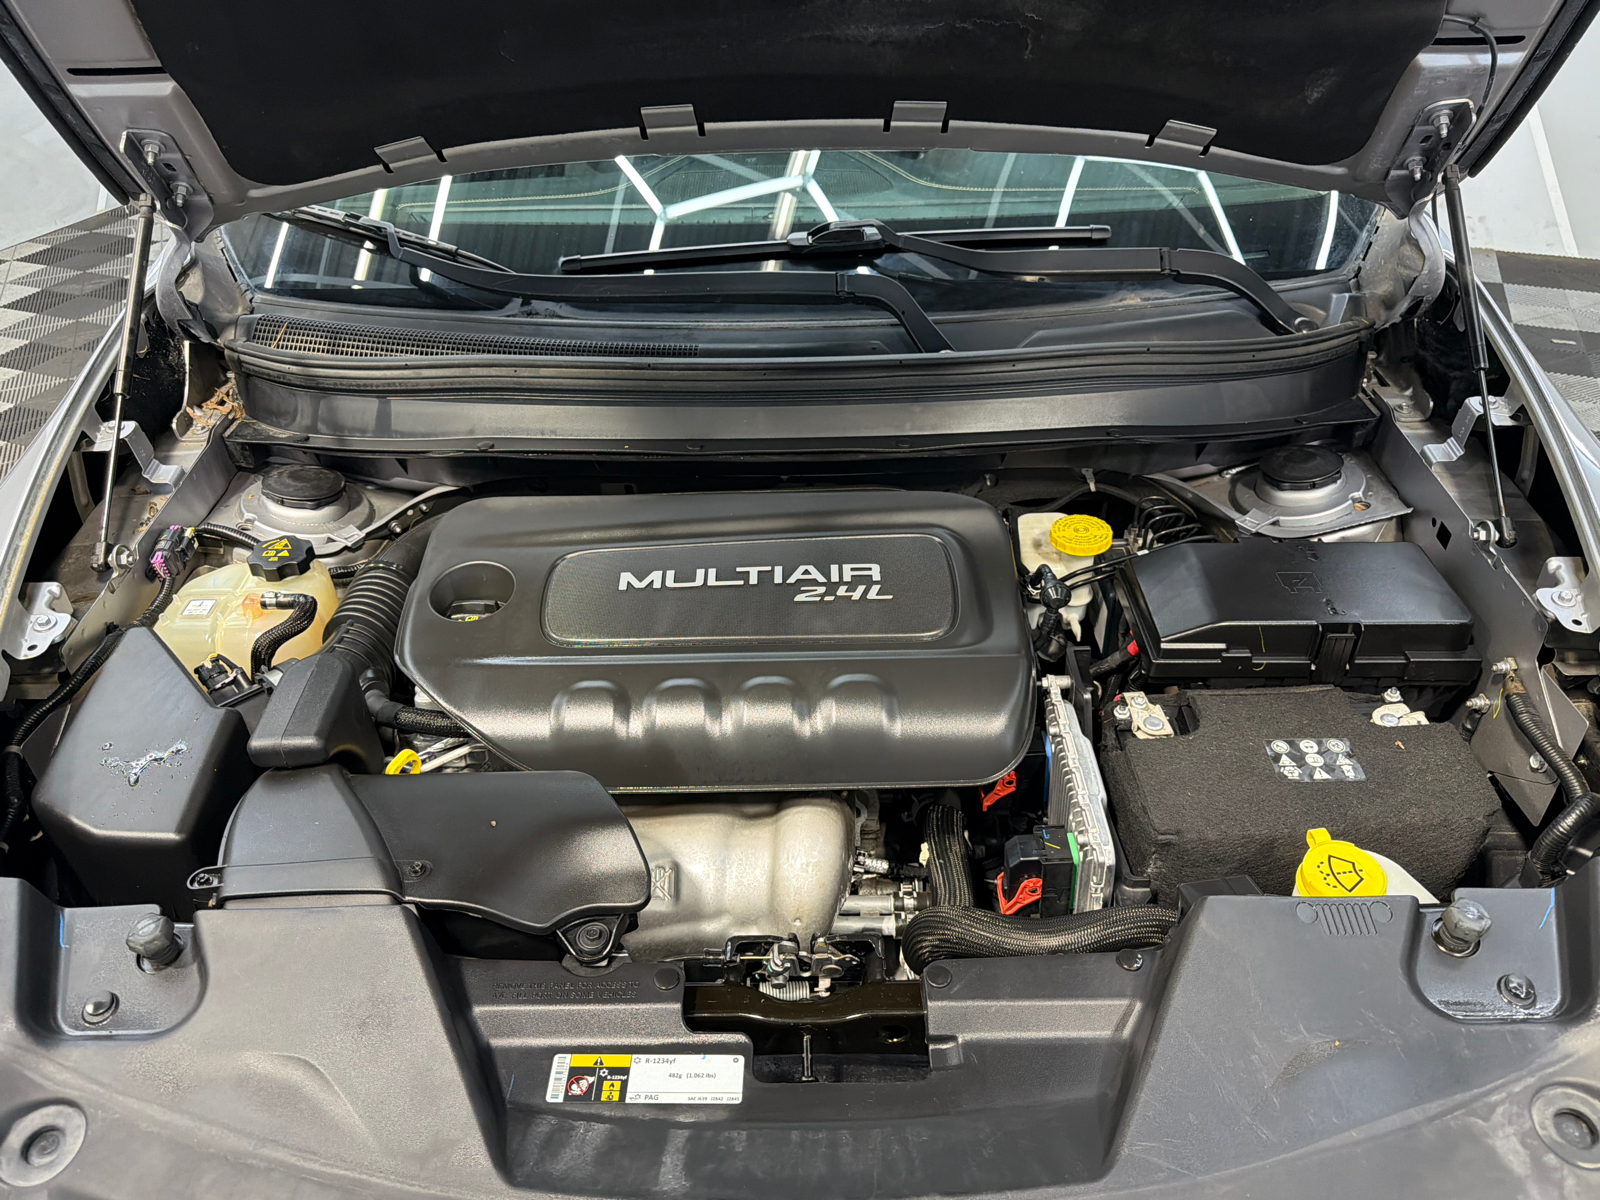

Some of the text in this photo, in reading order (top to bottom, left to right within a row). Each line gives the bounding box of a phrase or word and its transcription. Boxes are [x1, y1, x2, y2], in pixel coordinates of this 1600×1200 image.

[618, 563, 881, 591] MULTIAIR
[793, 584, 894, 602] 2.4L
[576, 981, 593, 989] FOR
[595, 981, 627, 989] ACCESS
[629, 981, 640, 989] TO
[555, 991, 568, 999] ON
[570, 991, 595, 999] SOME
[597, 990, 638, 999] VEHICLES
[645, 1057, 676, 1065] R-1234yf
